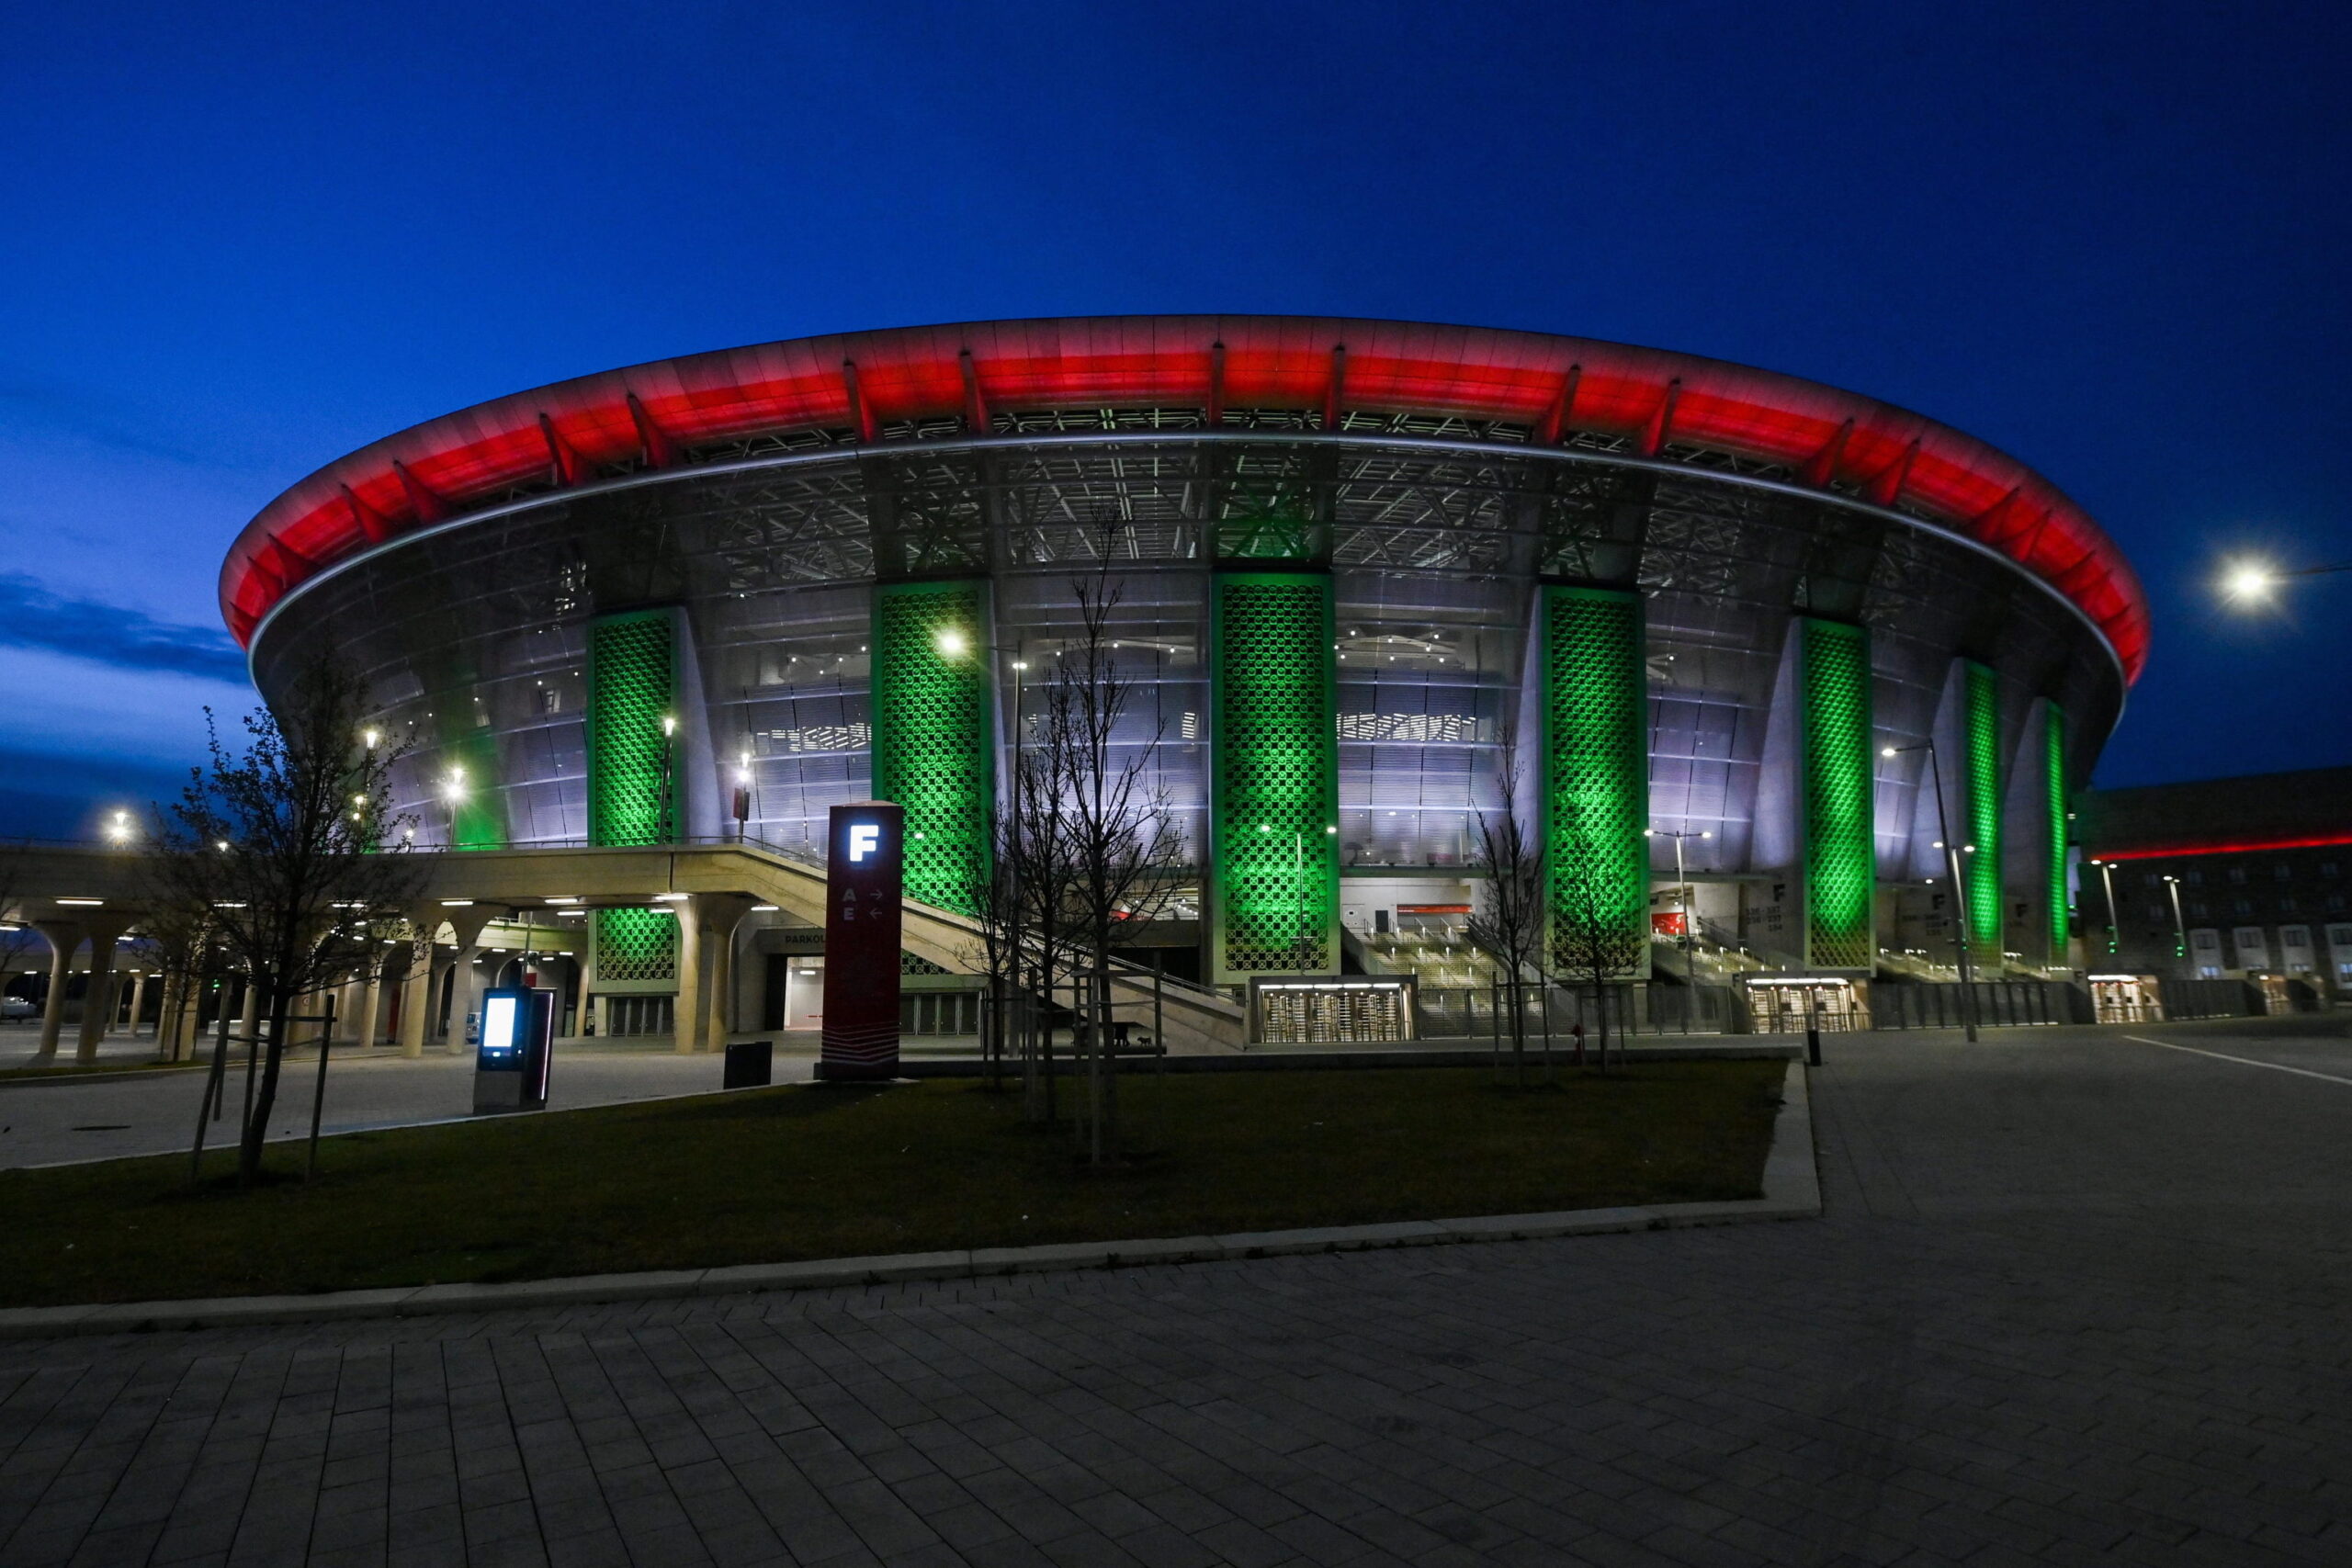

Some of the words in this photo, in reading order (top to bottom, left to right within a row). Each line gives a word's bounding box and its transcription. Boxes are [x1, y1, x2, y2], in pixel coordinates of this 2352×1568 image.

[850, 825, 879, 862] F
[842, 888, 857, 902] A
[1773, 884, 1785, 902] F
[1933, 895, 1945, 910] F
[843, 907, 854, 920] E
